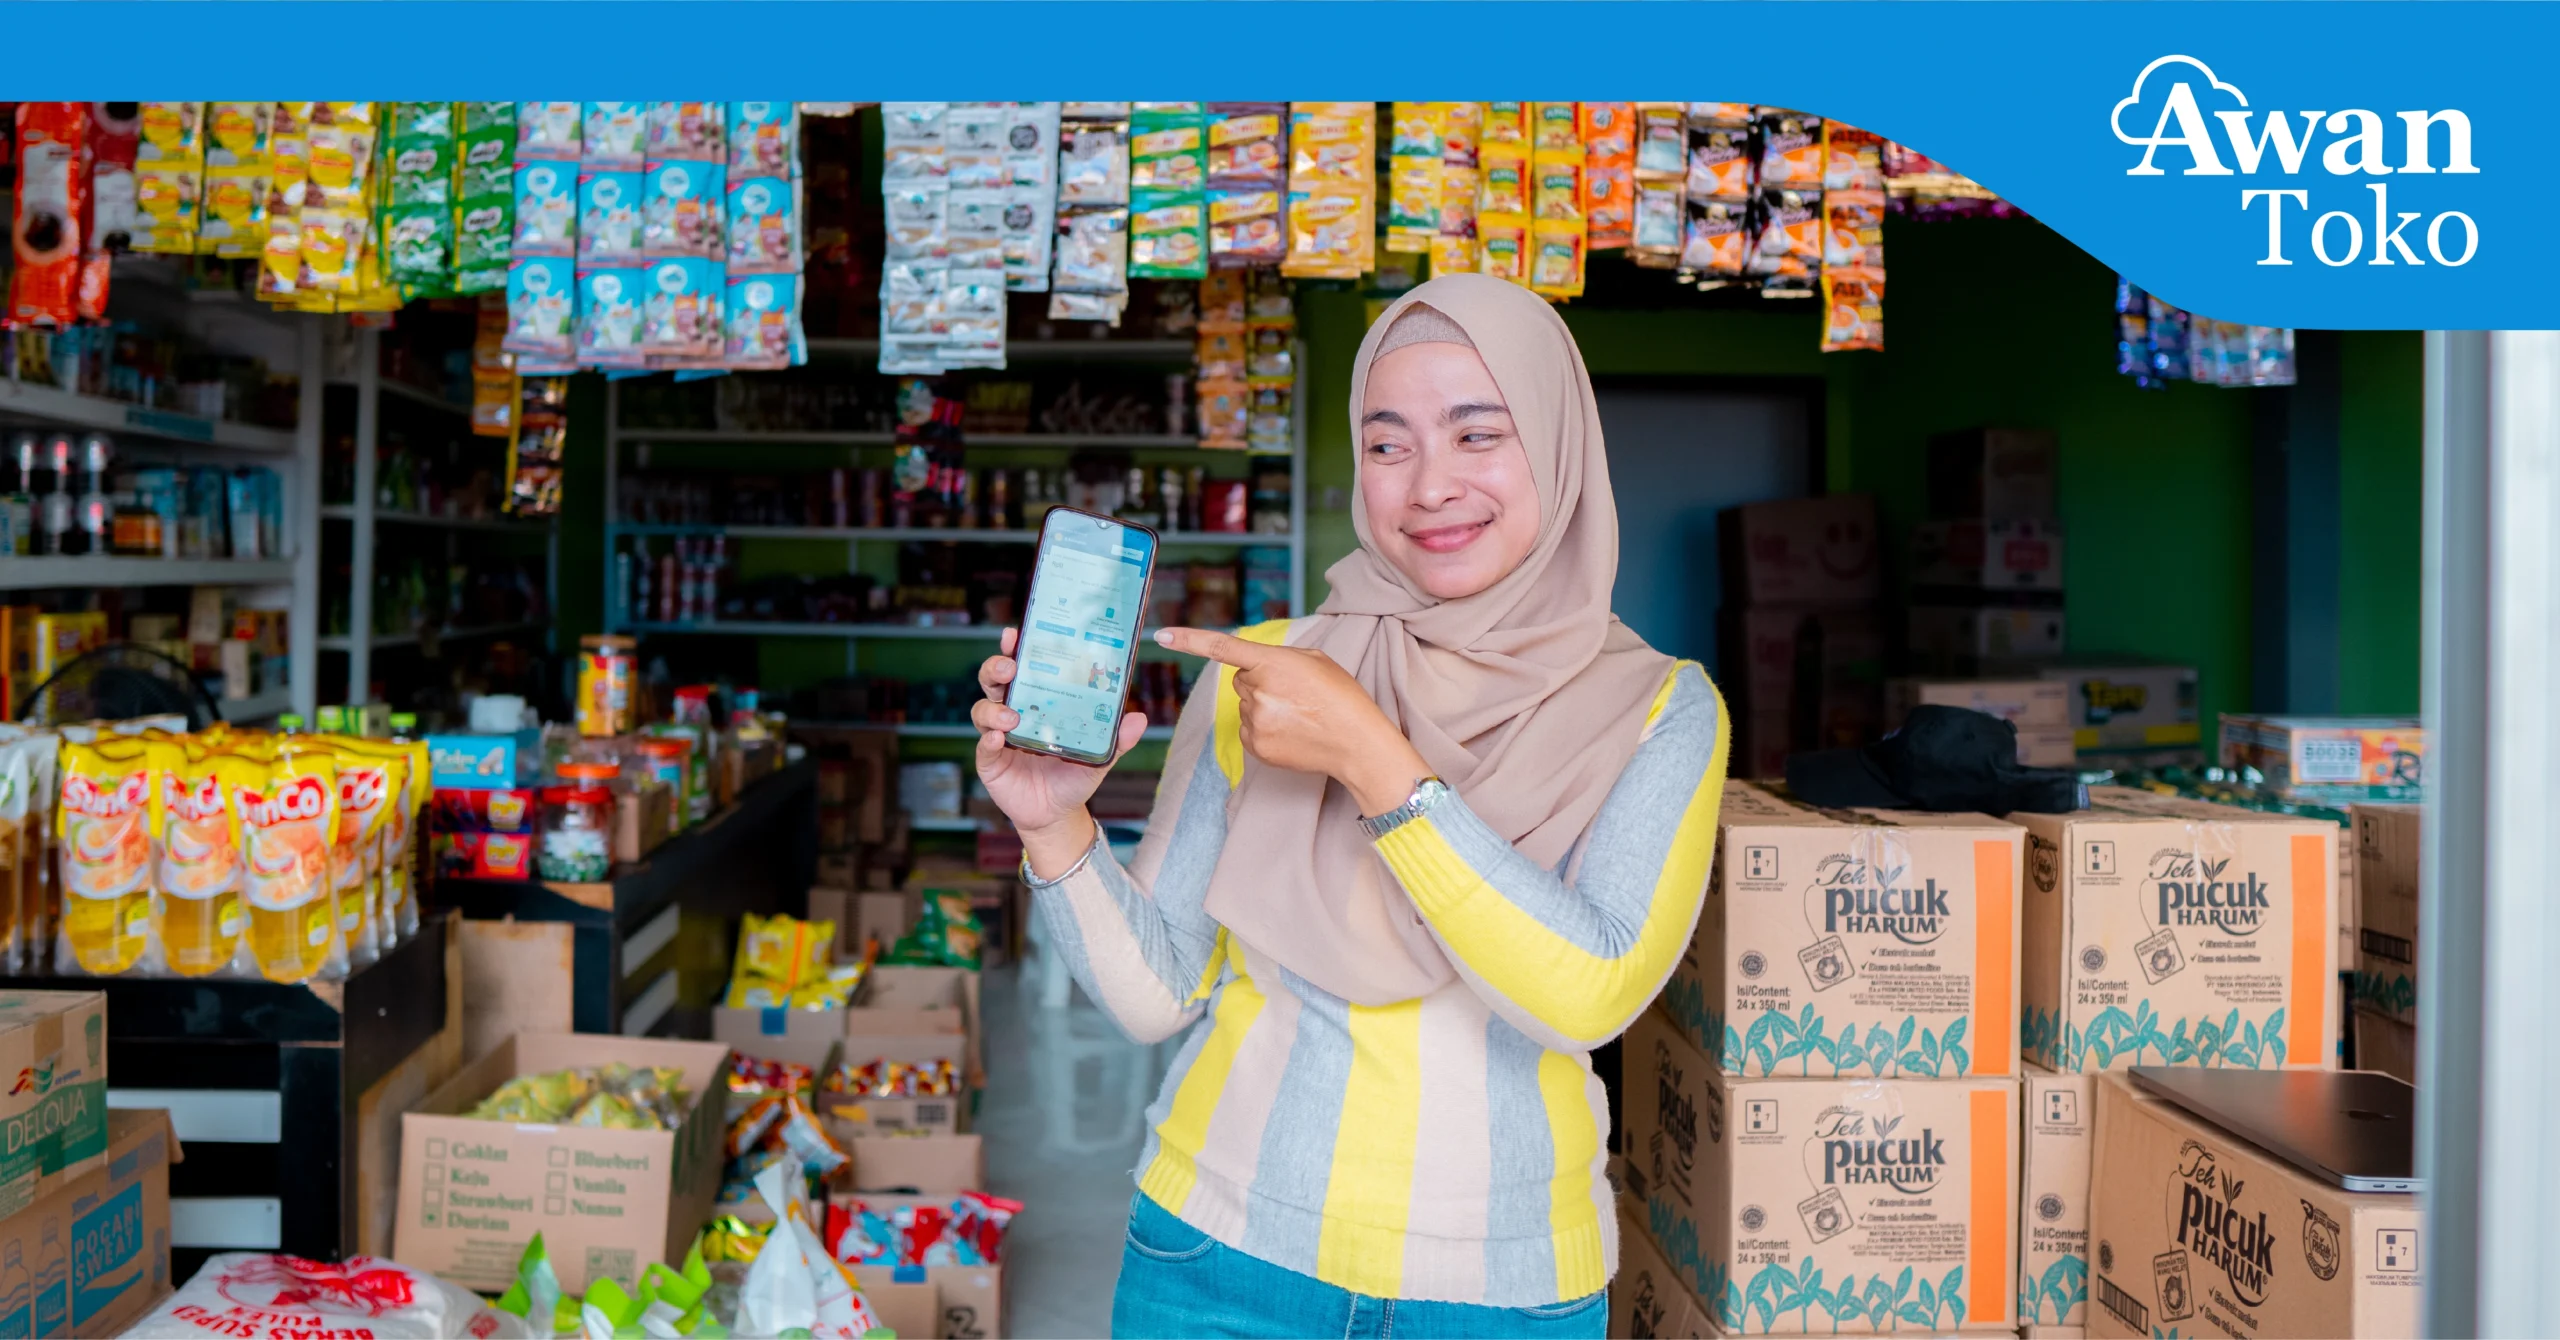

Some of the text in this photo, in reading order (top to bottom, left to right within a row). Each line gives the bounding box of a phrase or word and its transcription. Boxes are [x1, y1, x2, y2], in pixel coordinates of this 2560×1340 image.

[1815, 858, 1867, 887] Teh
[1825, 878, 1950, 933] pucuk
[2158, 872, 2270, 925] pucuk
[1846, 916, 1941, 941] HARUM
[2177, 909, 2258, 932] HARUM
[1737, 984, 1791, 997] Isi/Content:
[2078, 979, 2130, 991] Isi/Content:
[1736, 999, 1748, 1010] 24
[1759, 999, 1776, 1011] 350
[1778, 999, 1790, 1010] ml
[2078, 993, 2089, 1005] 24
[2099, 993, 2115, 1005] 350
[2117, 993, 2128, 1004] ml
[1815, 1111, 1866, 1138] Teh
[1824, 1128, 1946, 1184] pucuk
[2178, 1145, 2216, 1189] Teh
[1845, 1167, 1935, 1191] HARUM
[75, 1200, 140, 1262] POCARI
[2177, 1181, 2276, 1277] pucuk
[75, 1225, 134, 1288] SWEAT
[1738, 1239, 1791, 1250] Isi/Content:
[2033, 1241, 2045, 1252] 24
[2055, 1242, 2073, 1253] 350
[2074, 1242, 2087, 1253] ml
[2401, 1246, 2408, 1256] 7
[1737, 1253, 1748, 1264] 24
[1759, 1253, 1776, 1264] 350
[1778, 1253, 1790, 1263] ml
[2192, 1228, 2268, 1303] HARUM
